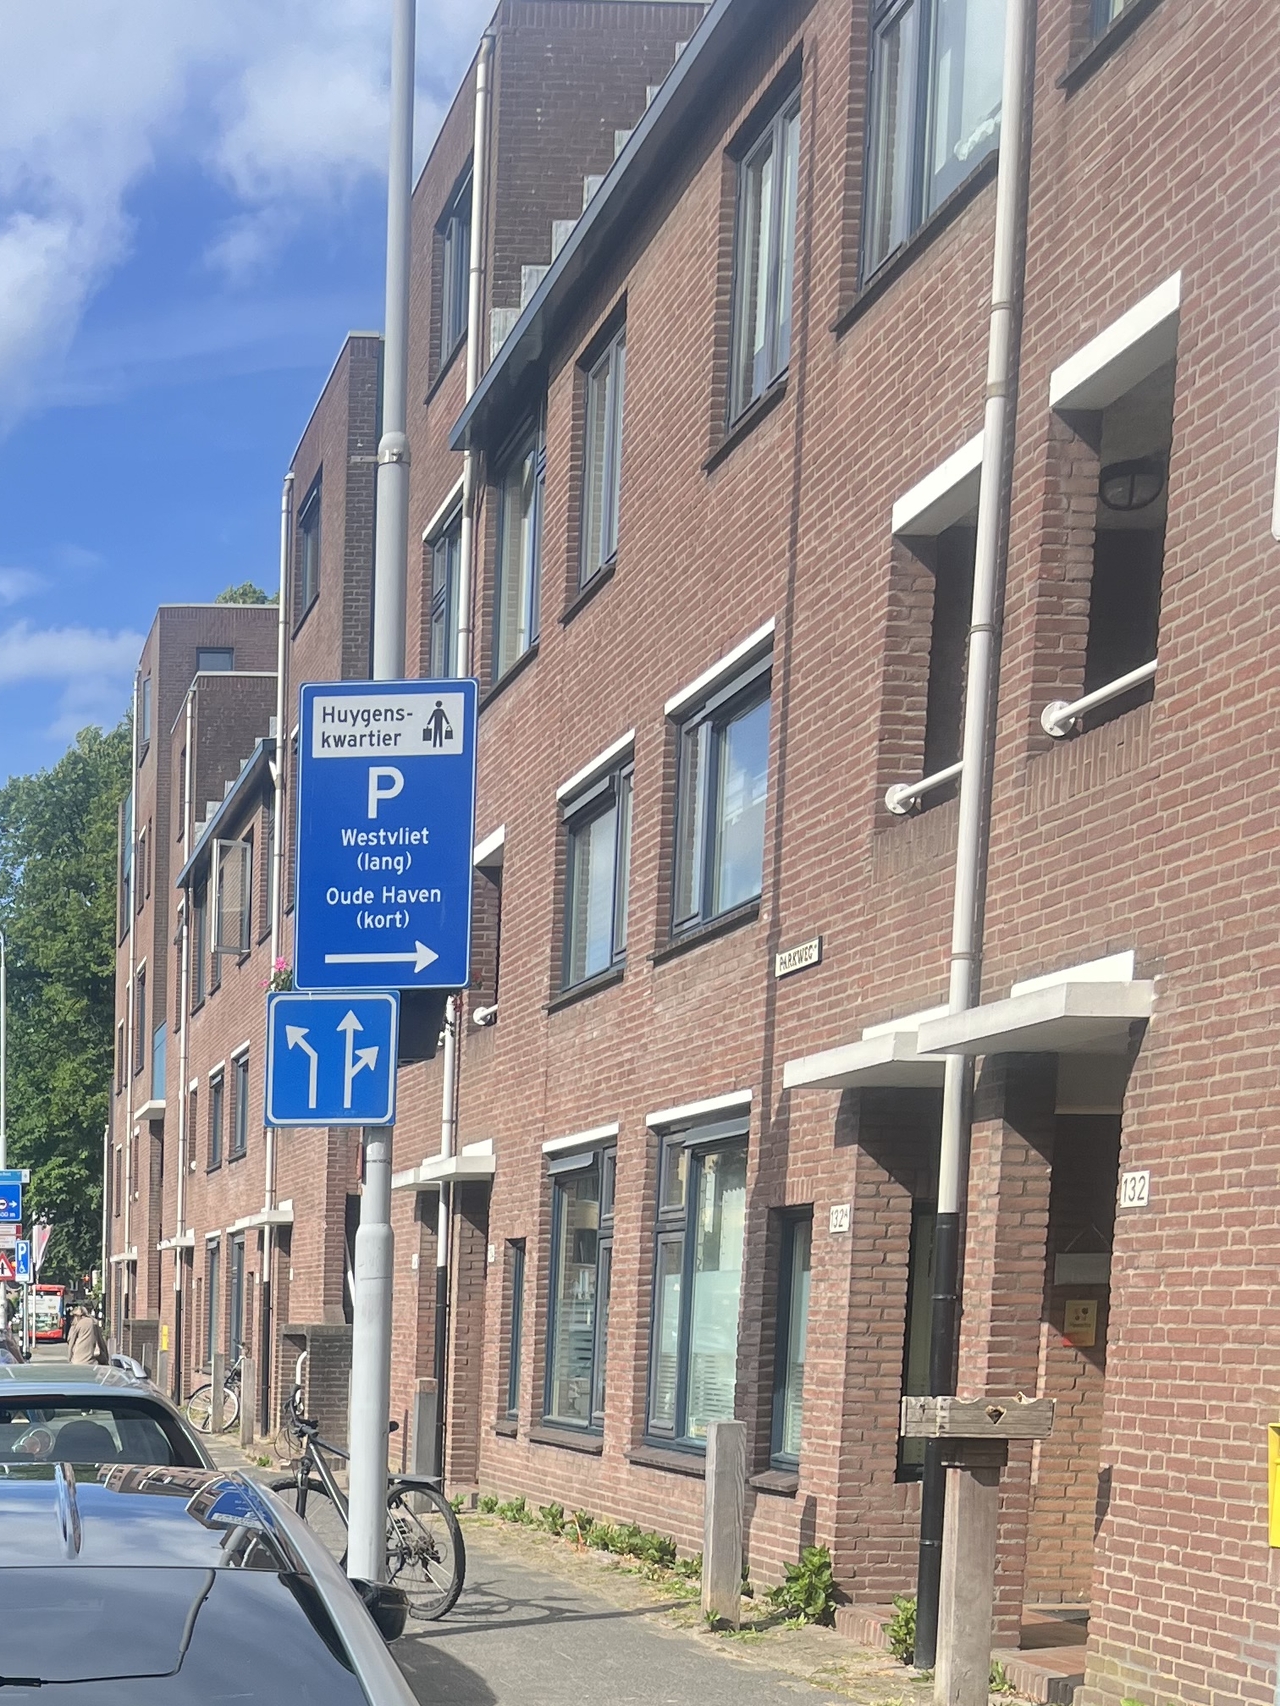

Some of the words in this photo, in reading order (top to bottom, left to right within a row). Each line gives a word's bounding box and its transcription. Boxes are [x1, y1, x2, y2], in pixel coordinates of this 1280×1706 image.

[322, 705, 413, 727] Huygens-
[321, 729, 402, 748] kwartier
[367, 766, 404, 819] P
[341, 827, 429, 847] Westvliet
[357, 851, 412, 875] (lang)
[326, 886, 374, 905] Oude
[382, 886, 441, 904] Haven
[357, 910, 410, 930] (kort)
[1122, 1175, 1147, 1203] 132
[18, 1243, 27, 1261] P
